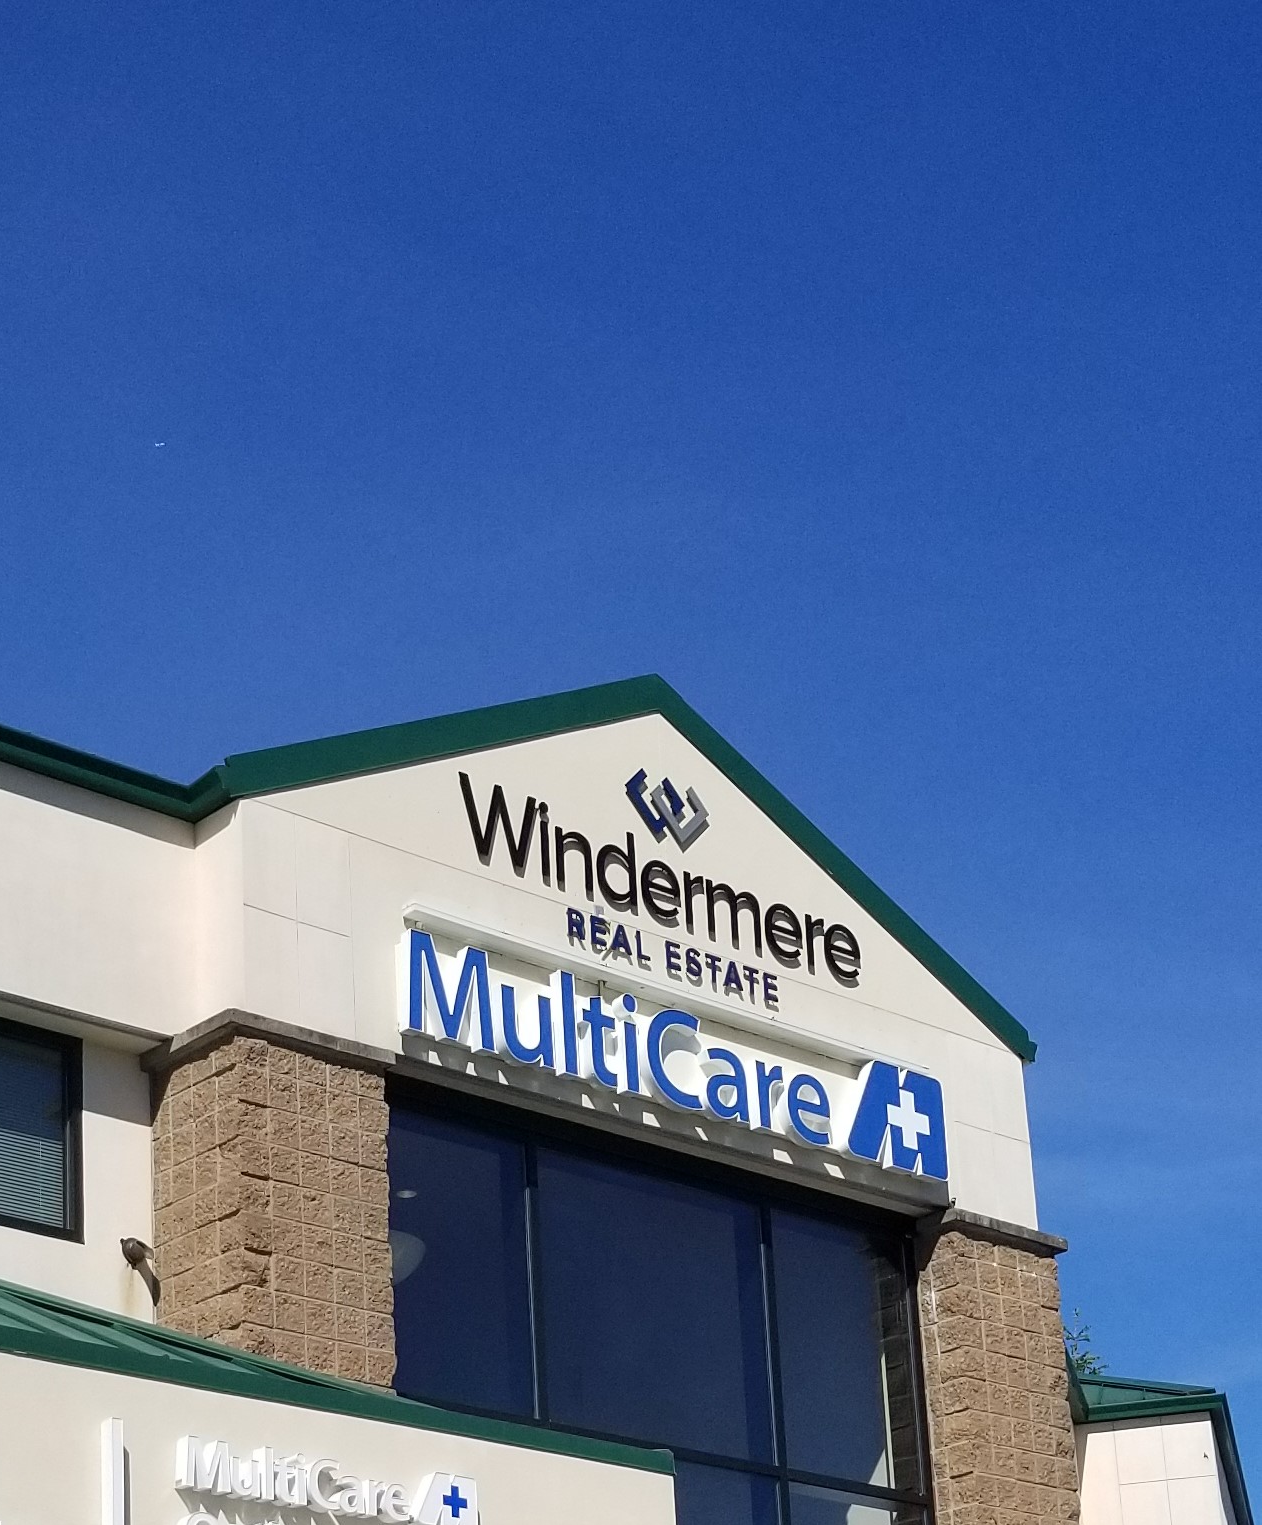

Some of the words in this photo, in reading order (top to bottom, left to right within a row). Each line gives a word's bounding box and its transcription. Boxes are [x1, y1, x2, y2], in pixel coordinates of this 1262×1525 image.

[458, 771, 861, 984] Windermere
[566, 906, 650, 963] REAL
[665, 940, 779, 1007] ESTATE
[402, 927, 832, 1147] MultiCare
[175, 1435, 412, 1524] MultiCare
